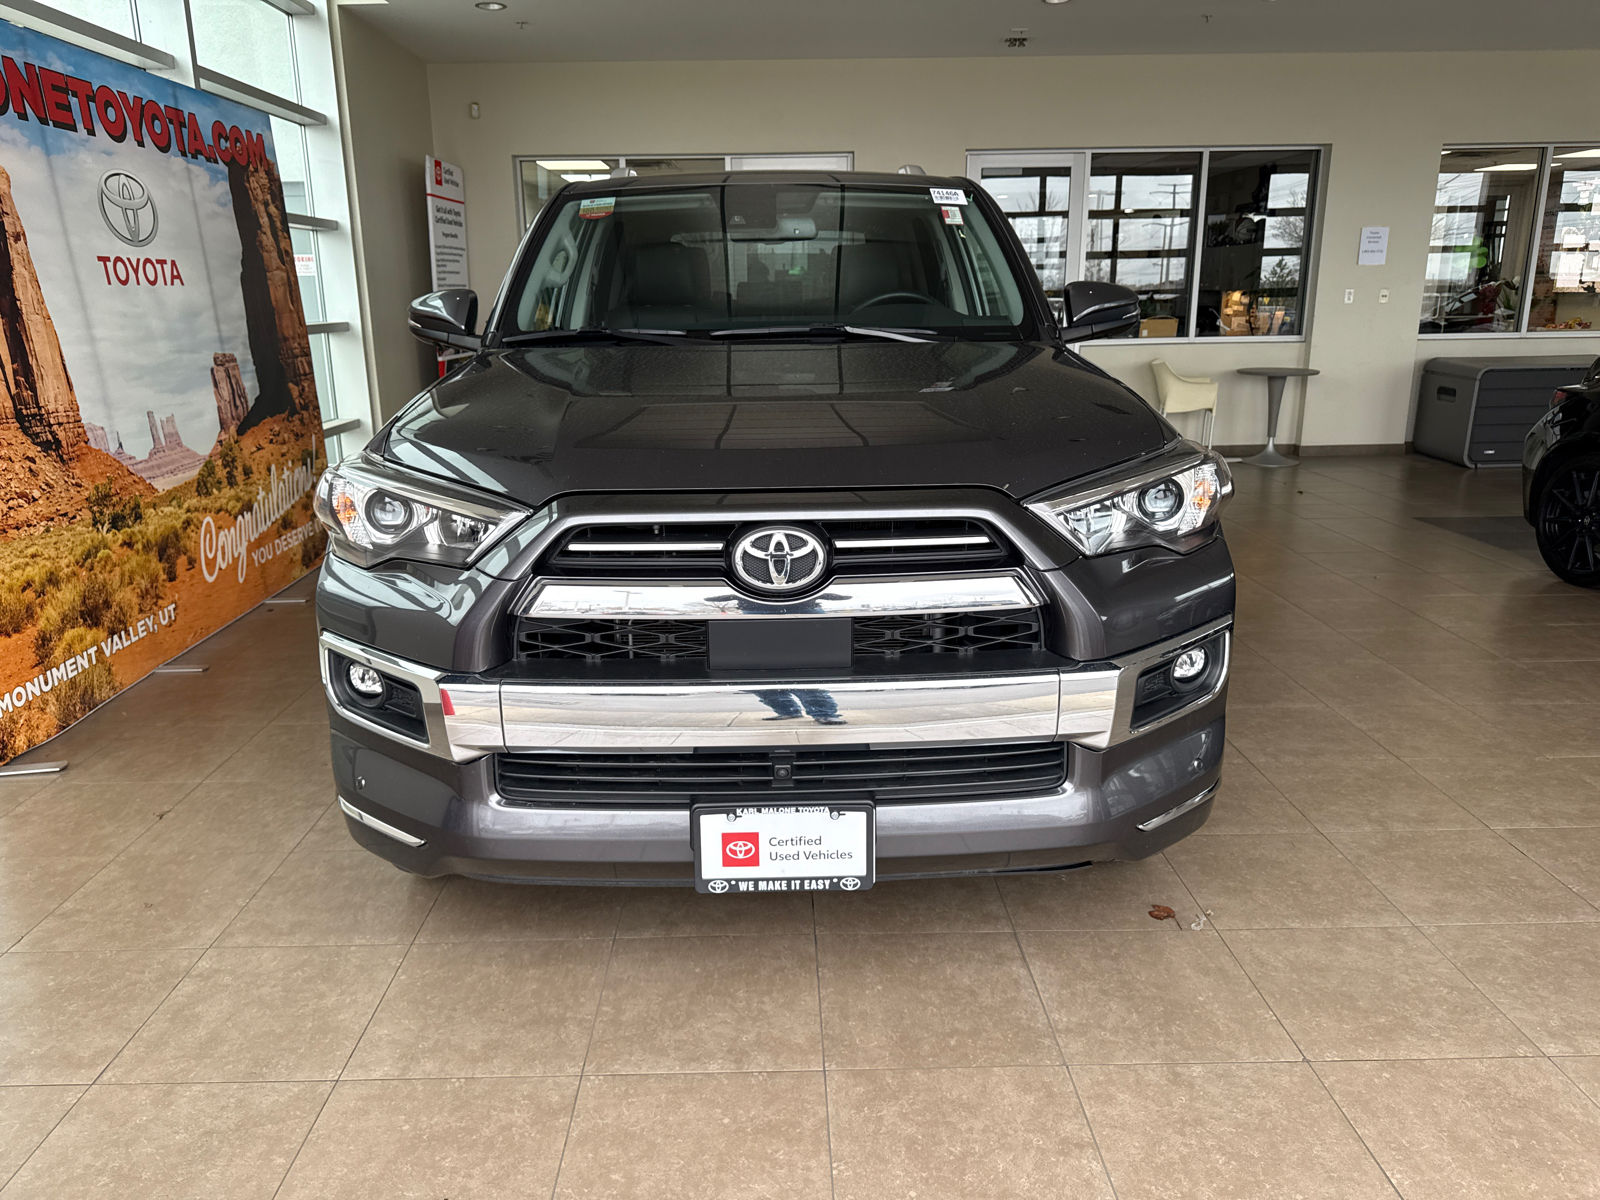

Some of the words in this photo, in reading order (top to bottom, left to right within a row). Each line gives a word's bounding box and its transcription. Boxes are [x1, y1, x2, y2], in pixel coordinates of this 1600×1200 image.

[0, 54, 269, 171] NETOYOTA.COM
[97, 256, 185, 286] TOYOTA
[200, 433, 316, 583] Congratulations!
[252, 543, 273, 567] YOU
[275, 521, 314, 555] DESERVE
[0, 646, 98, 719] MONUMENT
[101, 615, 158, 657] VALLEY,
[159, 603, 177, 626] UT
[736, 808, 760, 816] KARL
[761, 807, 796, 815] MALONE
[769, 836, 822, 847] Certified
[769, 850, 800, 861] Used
[803, 849, 853, 860] Vehicles
[738, 880, 754, 891] WE
[758, 879, 788, 891] MAKE
[791, 879, 801, 890] IT
[804, 879, 831, 890] EASY
